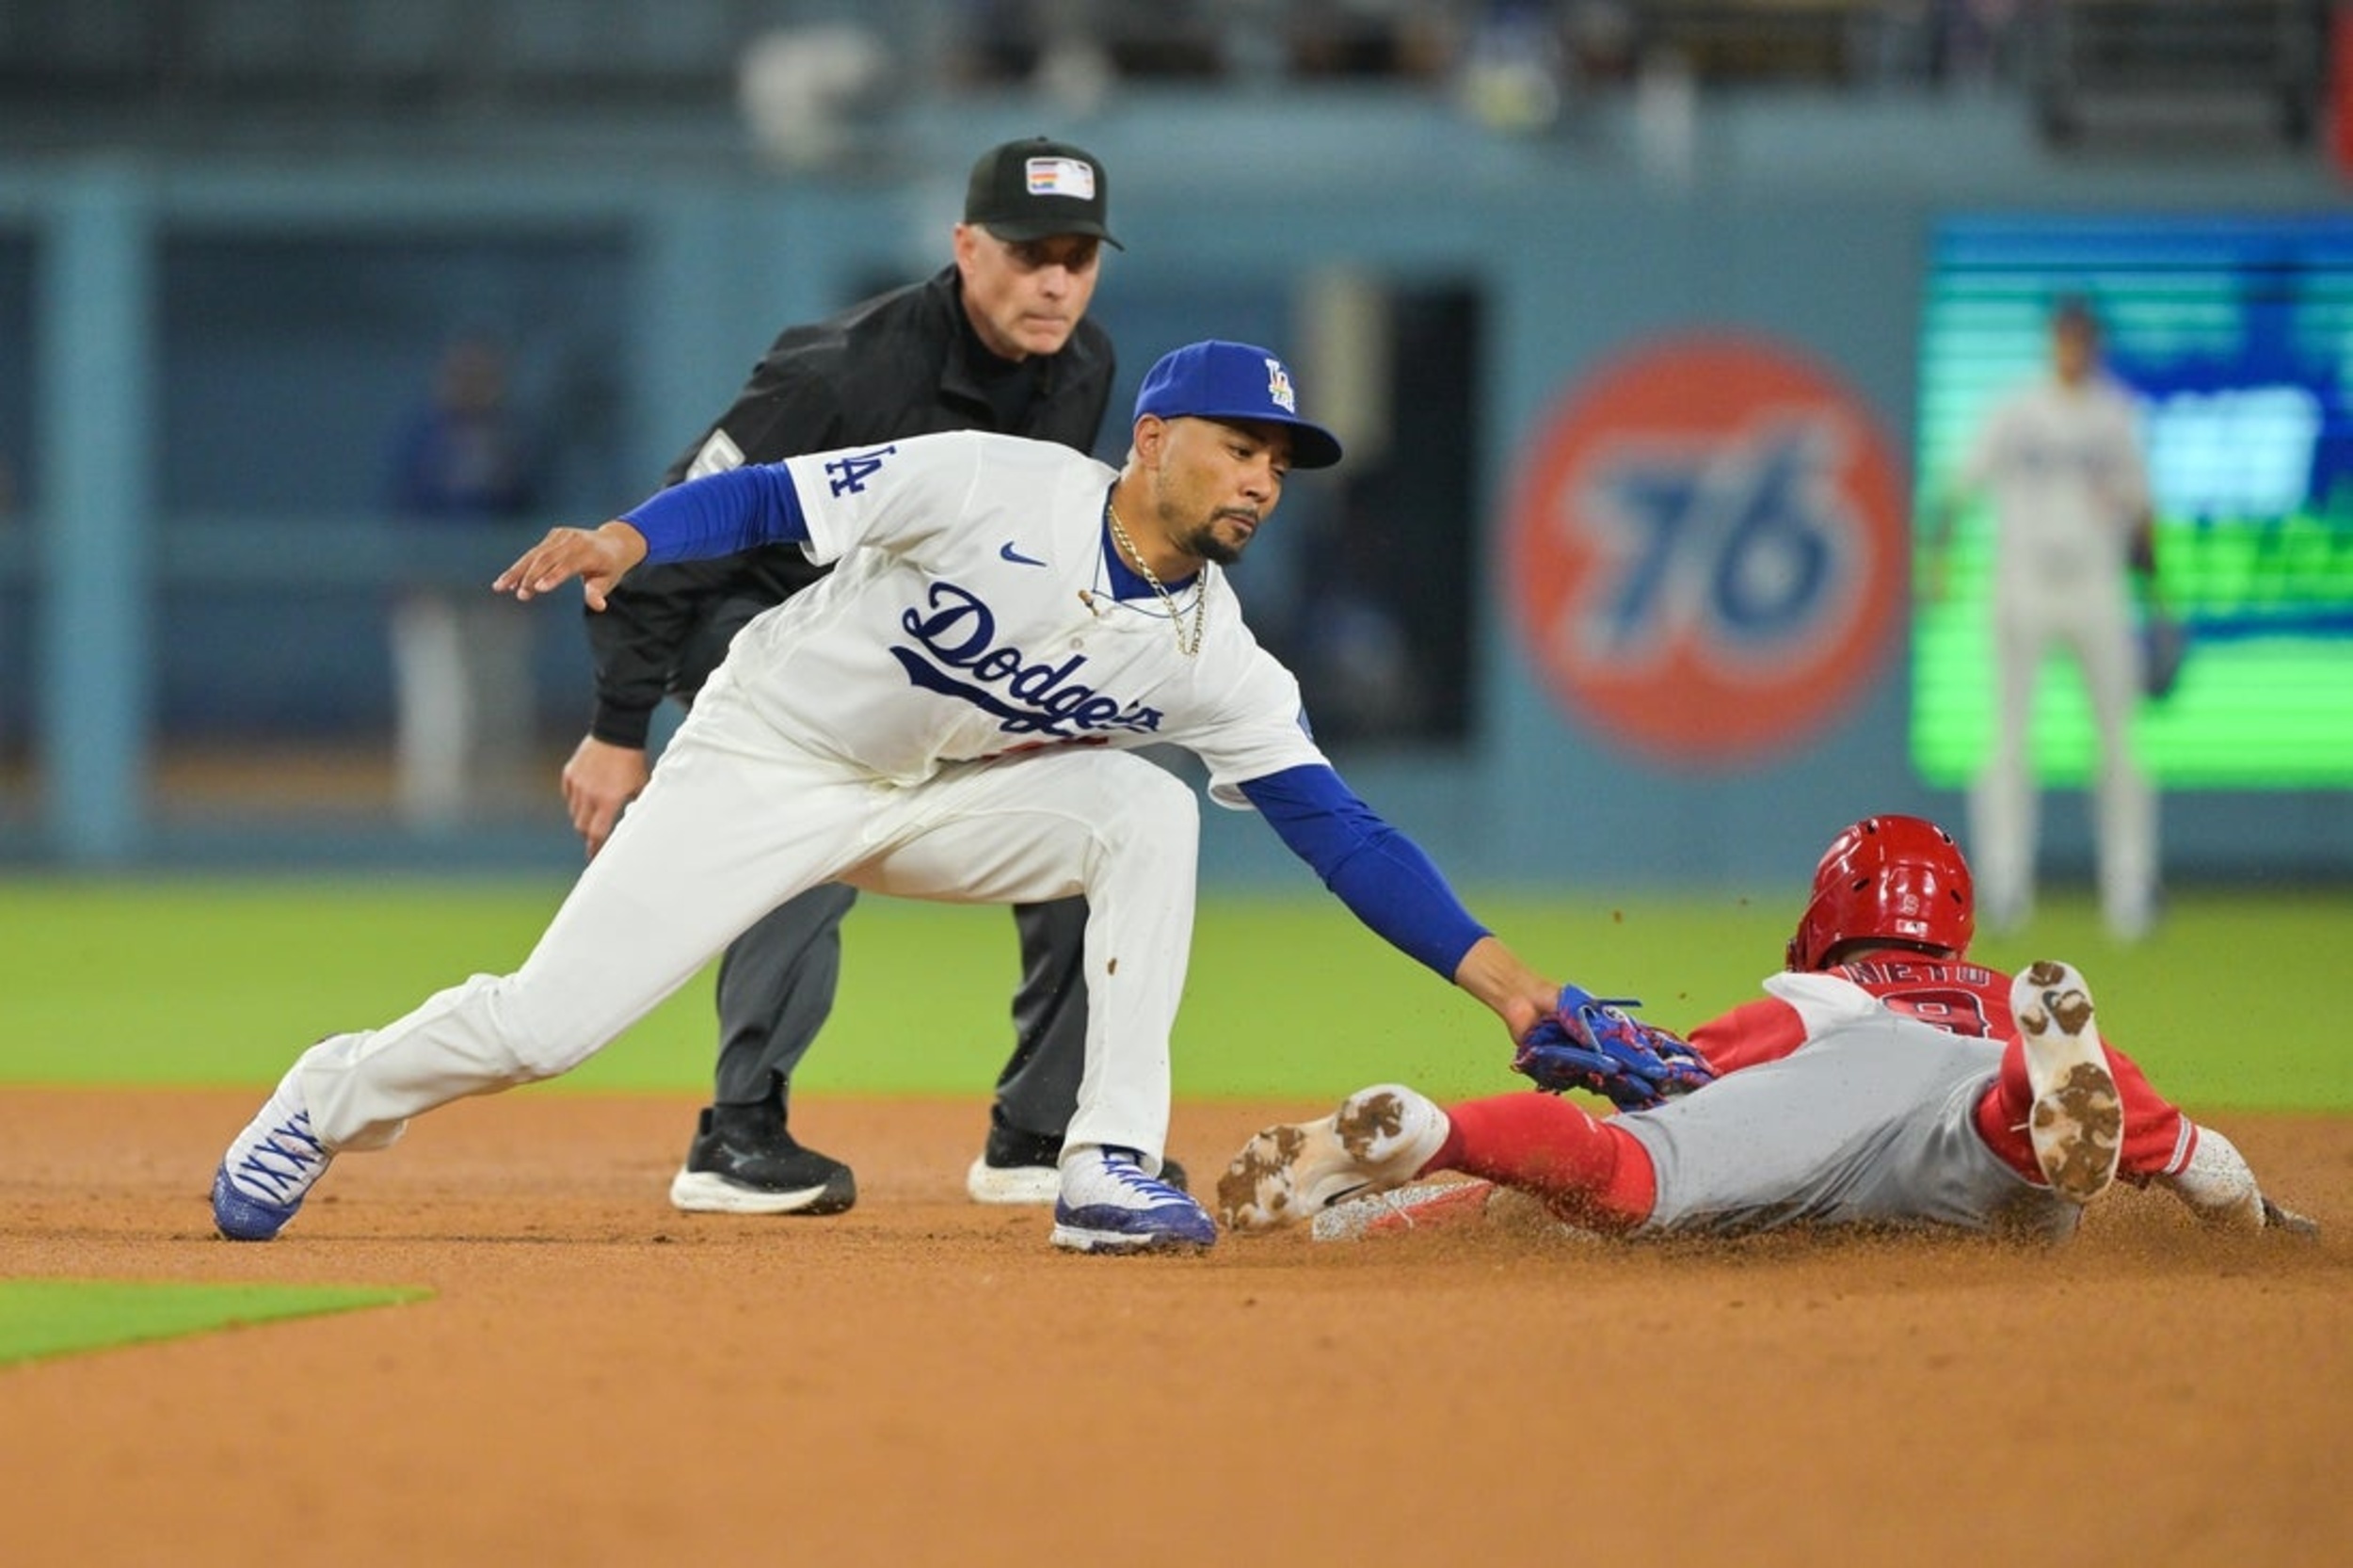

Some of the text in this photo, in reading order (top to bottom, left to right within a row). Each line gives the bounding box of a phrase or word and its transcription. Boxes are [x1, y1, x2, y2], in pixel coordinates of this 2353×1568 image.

[1265, 359, 1295, 413] LA
[824, 445, 897, 498] LA
[1564, 418, 1867, 680] 76
